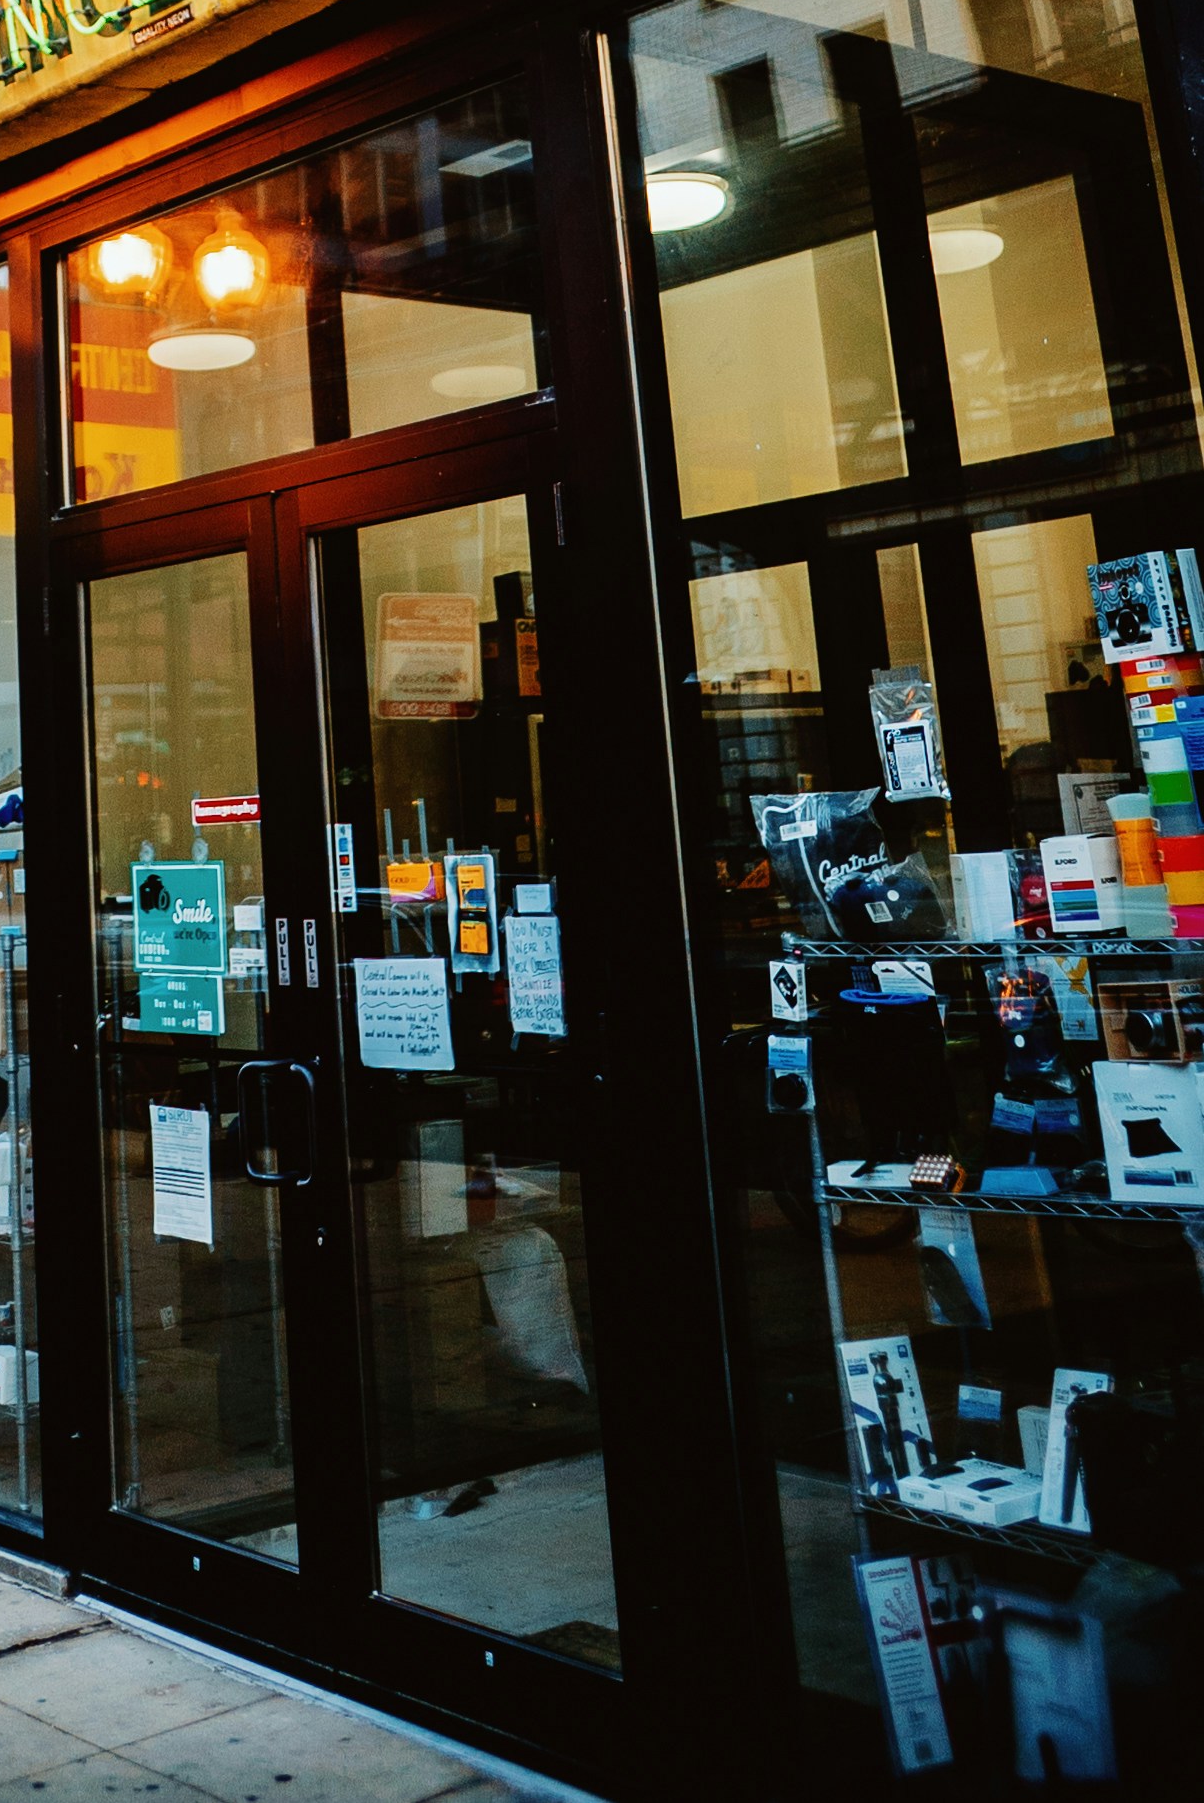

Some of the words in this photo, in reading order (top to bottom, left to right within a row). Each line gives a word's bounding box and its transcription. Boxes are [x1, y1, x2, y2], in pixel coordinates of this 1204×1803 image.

[166, 7, 191, 30] NEON
[818, 841, 888, 884] Central
[279, 920, 287, 971] PULL
[306, 921, 315, 973] PULL
[512, 943, 538, 955] WEAR
[545, 941, 553, 953] A
[517, 976, 553, 991] SANITIZE
[167, 1110, 193, 1123] SIRUI
